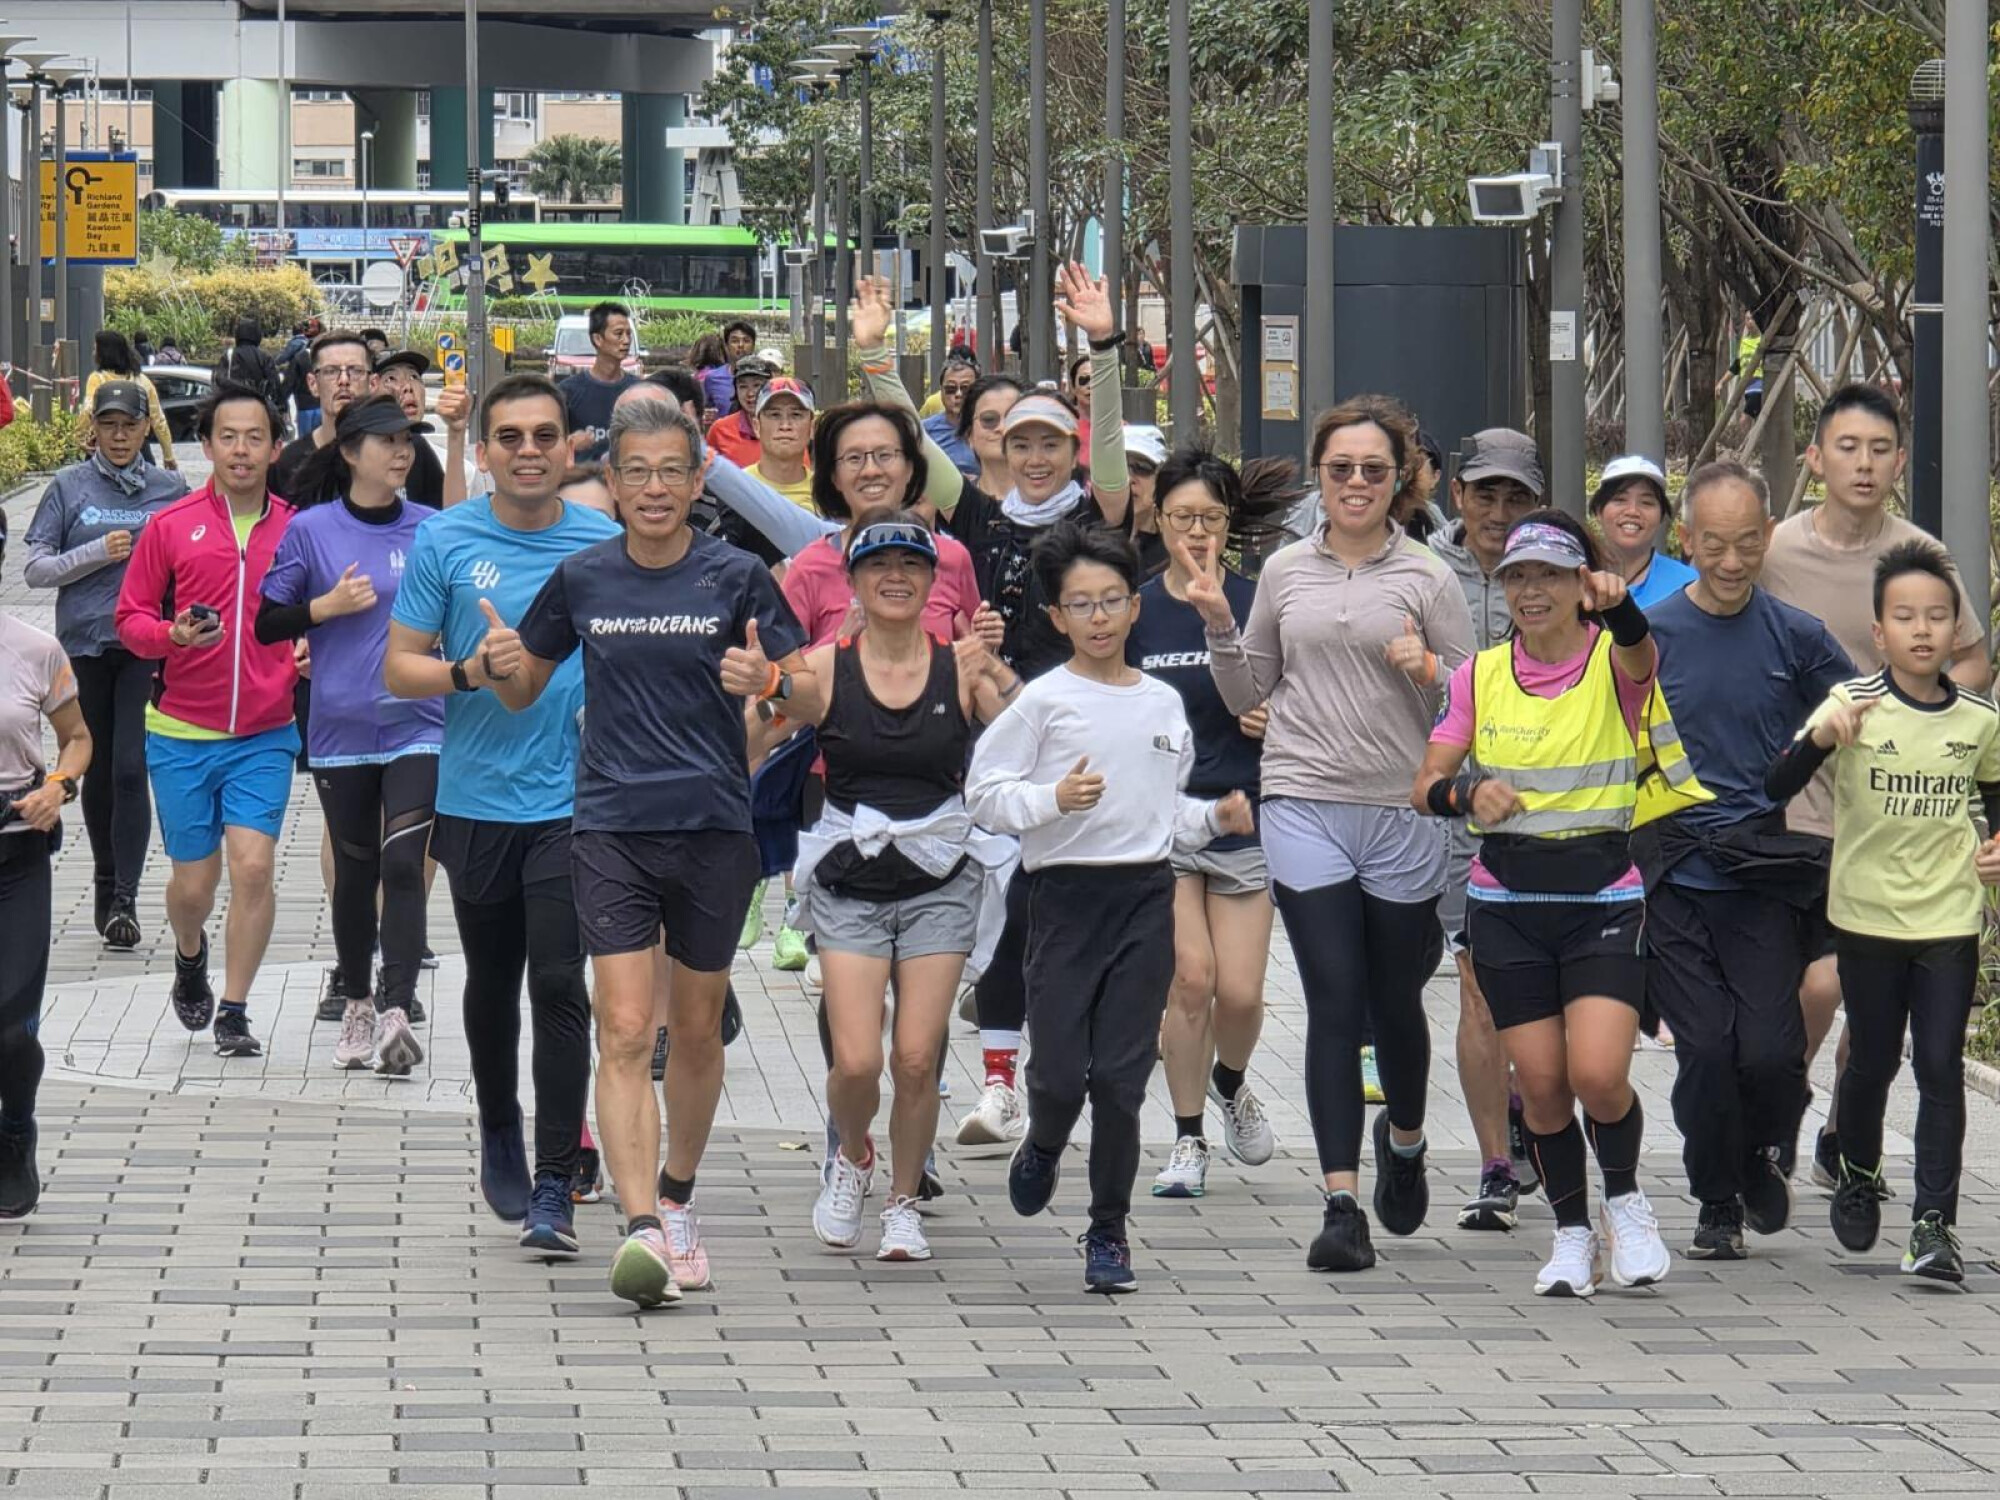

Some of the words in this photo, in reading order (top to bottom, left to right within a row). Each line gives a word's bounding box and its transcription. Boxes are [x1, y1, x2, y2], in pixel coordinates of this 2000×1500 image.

[87, 193, 122, 201] Richland
[87, 232, 102, 241] Bay
[590, 617, 631, 635] RUN
[648, 615, 720, 635] OCEANS
[1142, 651, 1210, 669] SKECH
[1884, 796, 1909, 816] FLY
